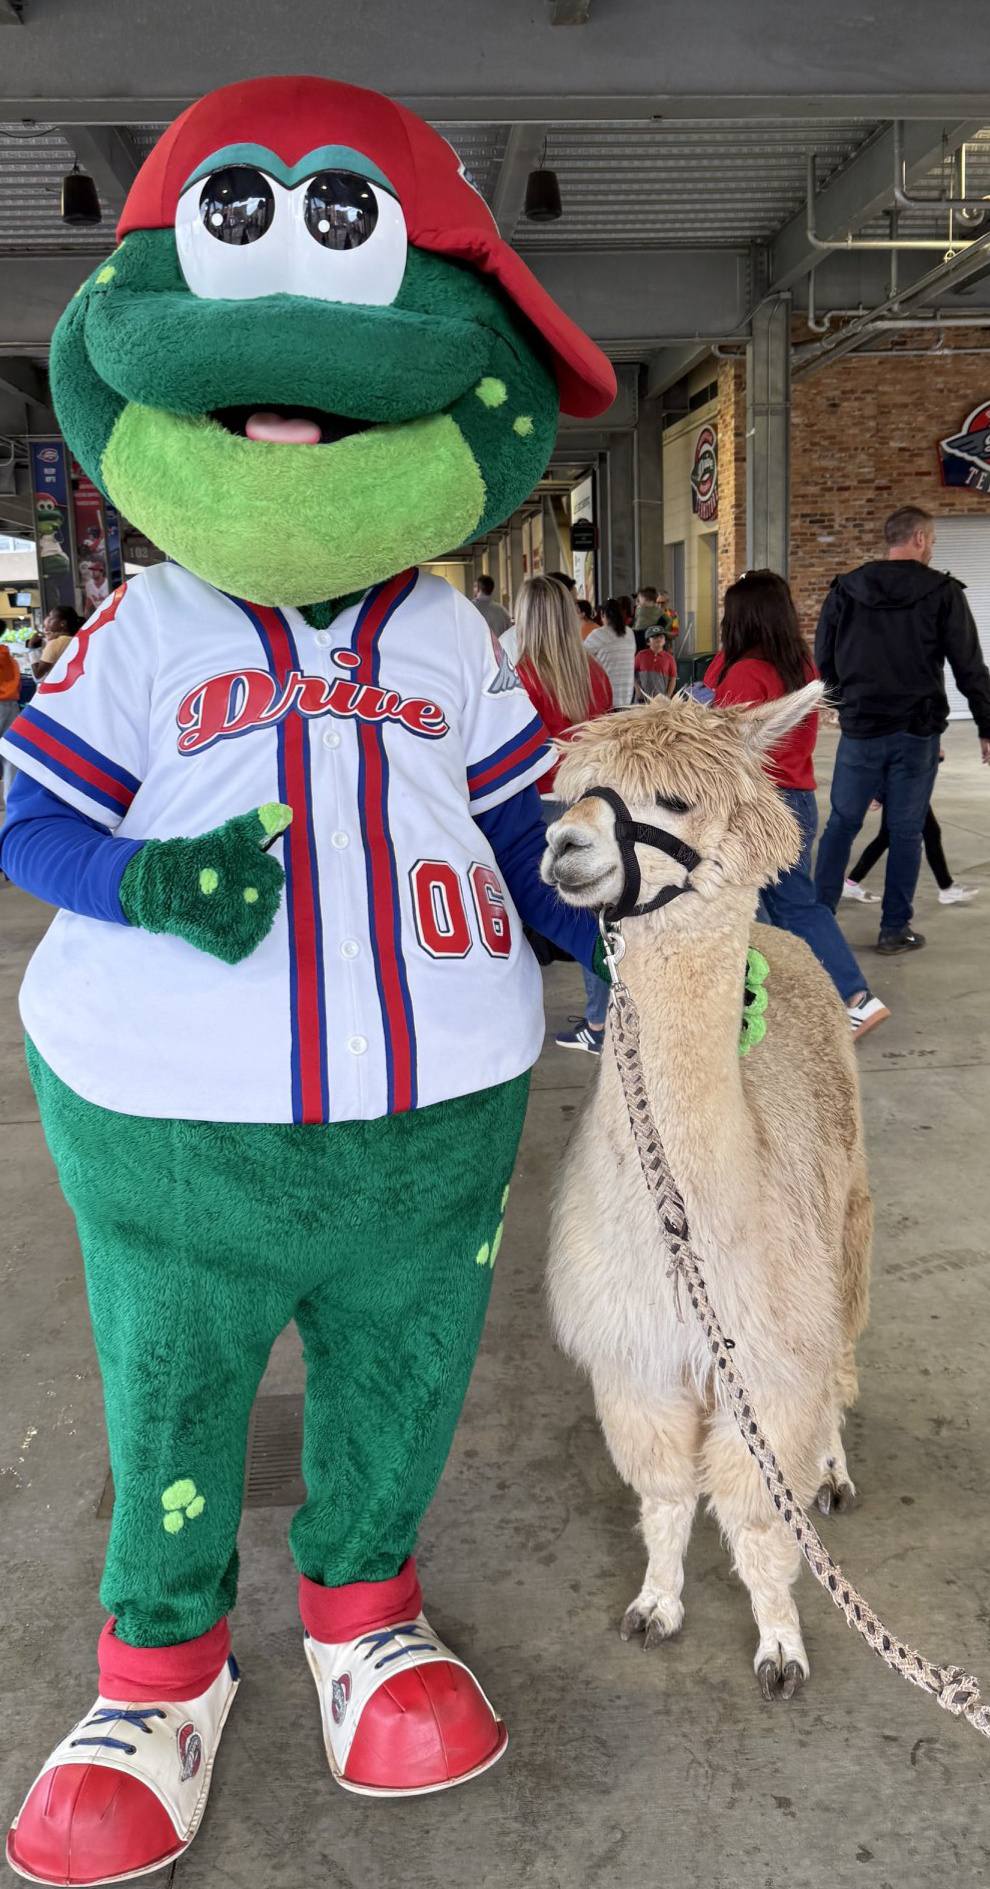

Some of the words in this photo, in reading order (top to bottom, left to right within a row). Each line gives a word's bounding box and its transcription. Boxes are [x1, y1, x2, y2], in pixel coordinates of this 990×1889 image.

[966, 467, 990, 492] TE
[176, 647, 450, 757] Drive
[408, 858, 512, 959] 06
